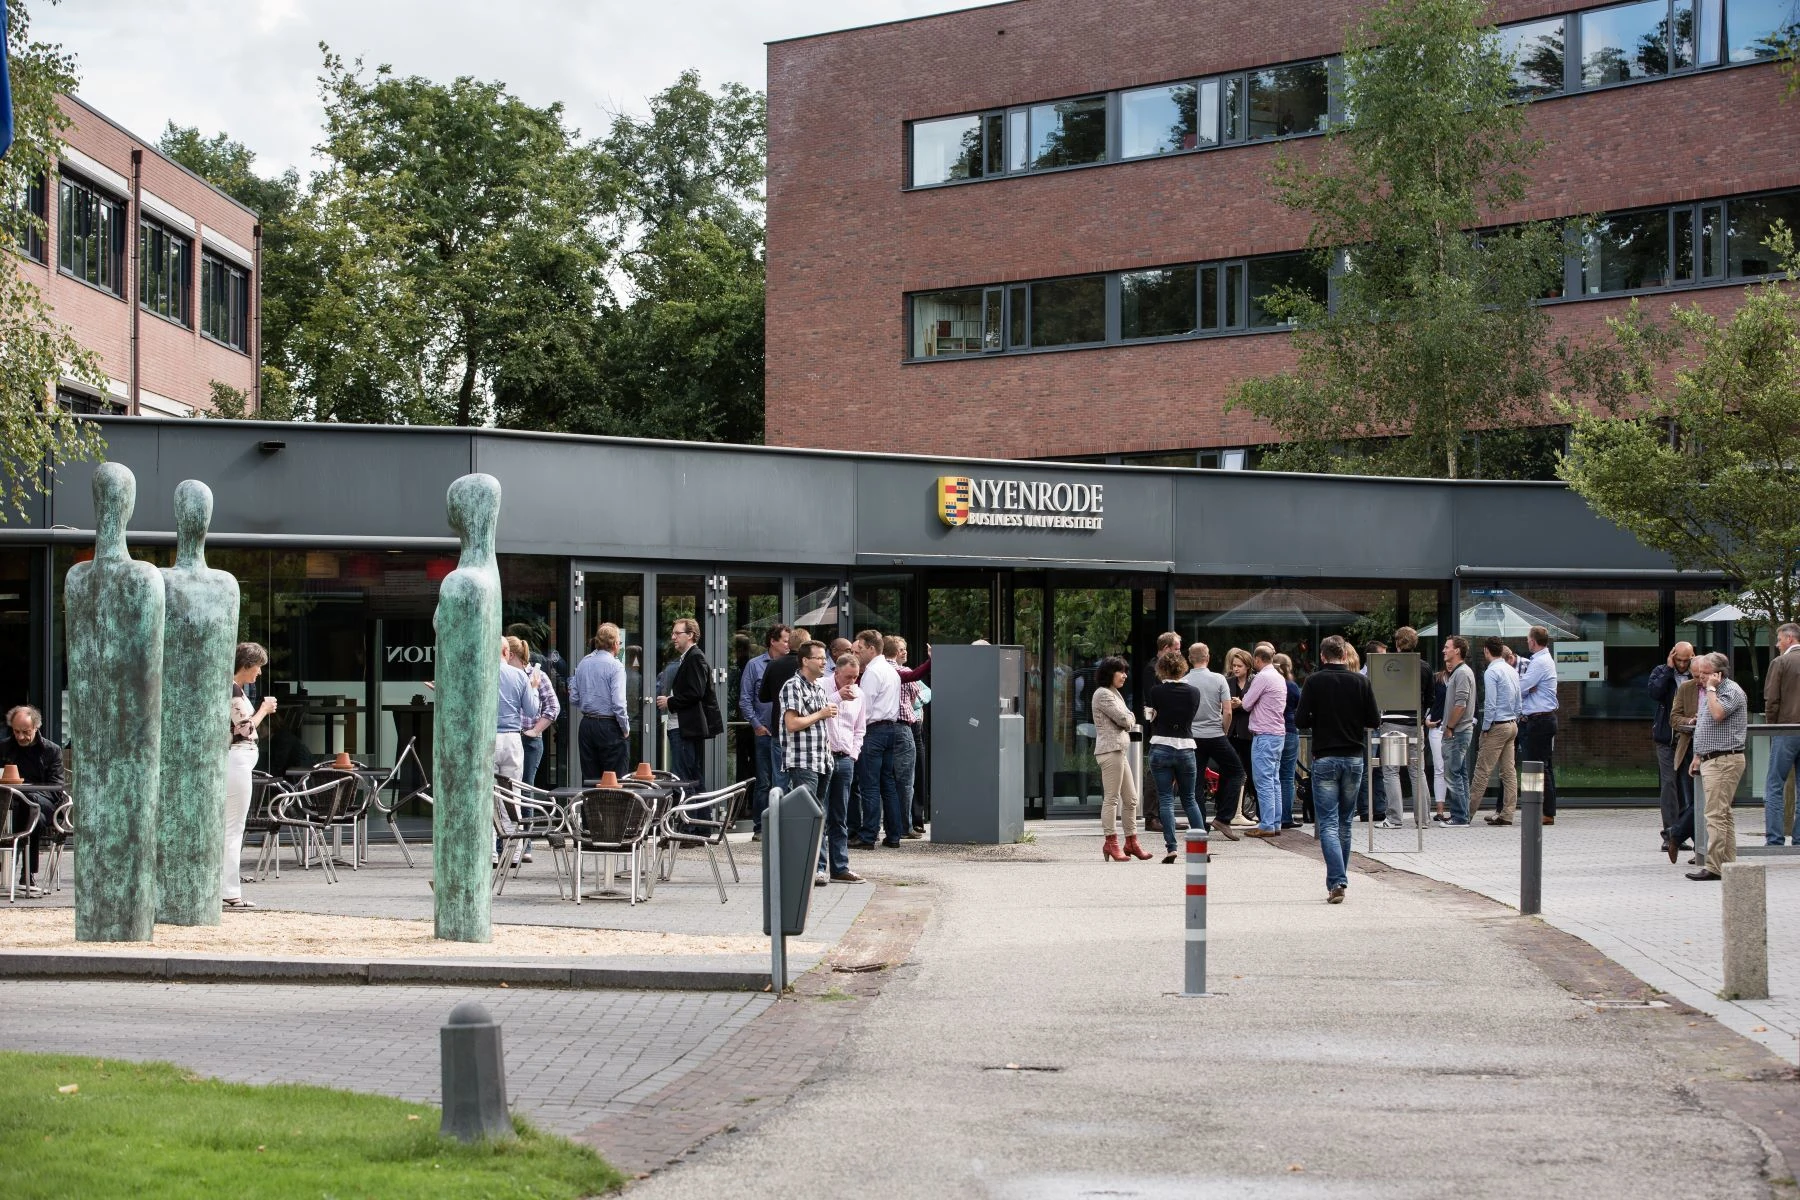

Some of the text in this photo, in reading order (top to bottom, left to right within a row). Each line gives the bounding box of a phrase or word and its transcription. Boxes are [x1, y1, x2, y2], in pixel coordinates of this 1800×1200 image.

[969, 479, 1103, 513] NYENRODE
[967, 512, 1104, 530] BUSINESS UNIVERSITEIT
